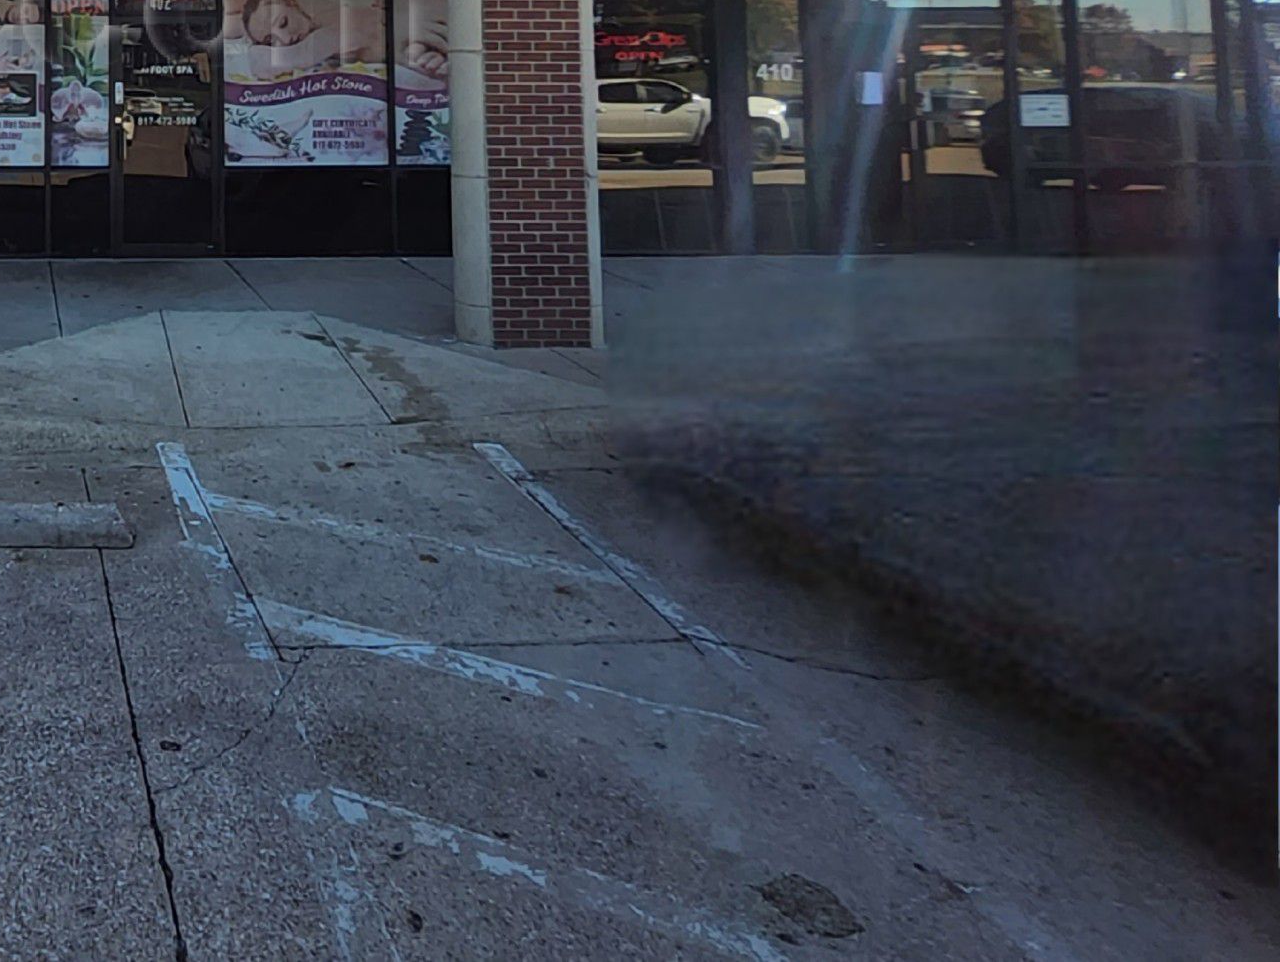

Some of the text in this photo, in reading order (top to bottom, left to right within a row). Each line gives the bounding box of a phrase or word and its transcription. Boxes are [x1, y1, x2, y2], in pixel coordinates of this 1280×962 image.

[150, 65, 175, 74] FOOT
[176, 65, 194, 74] SPA
[756, 64, 793, 81] 410
[239, 76, 372, 103] Swedish Hot Stone
